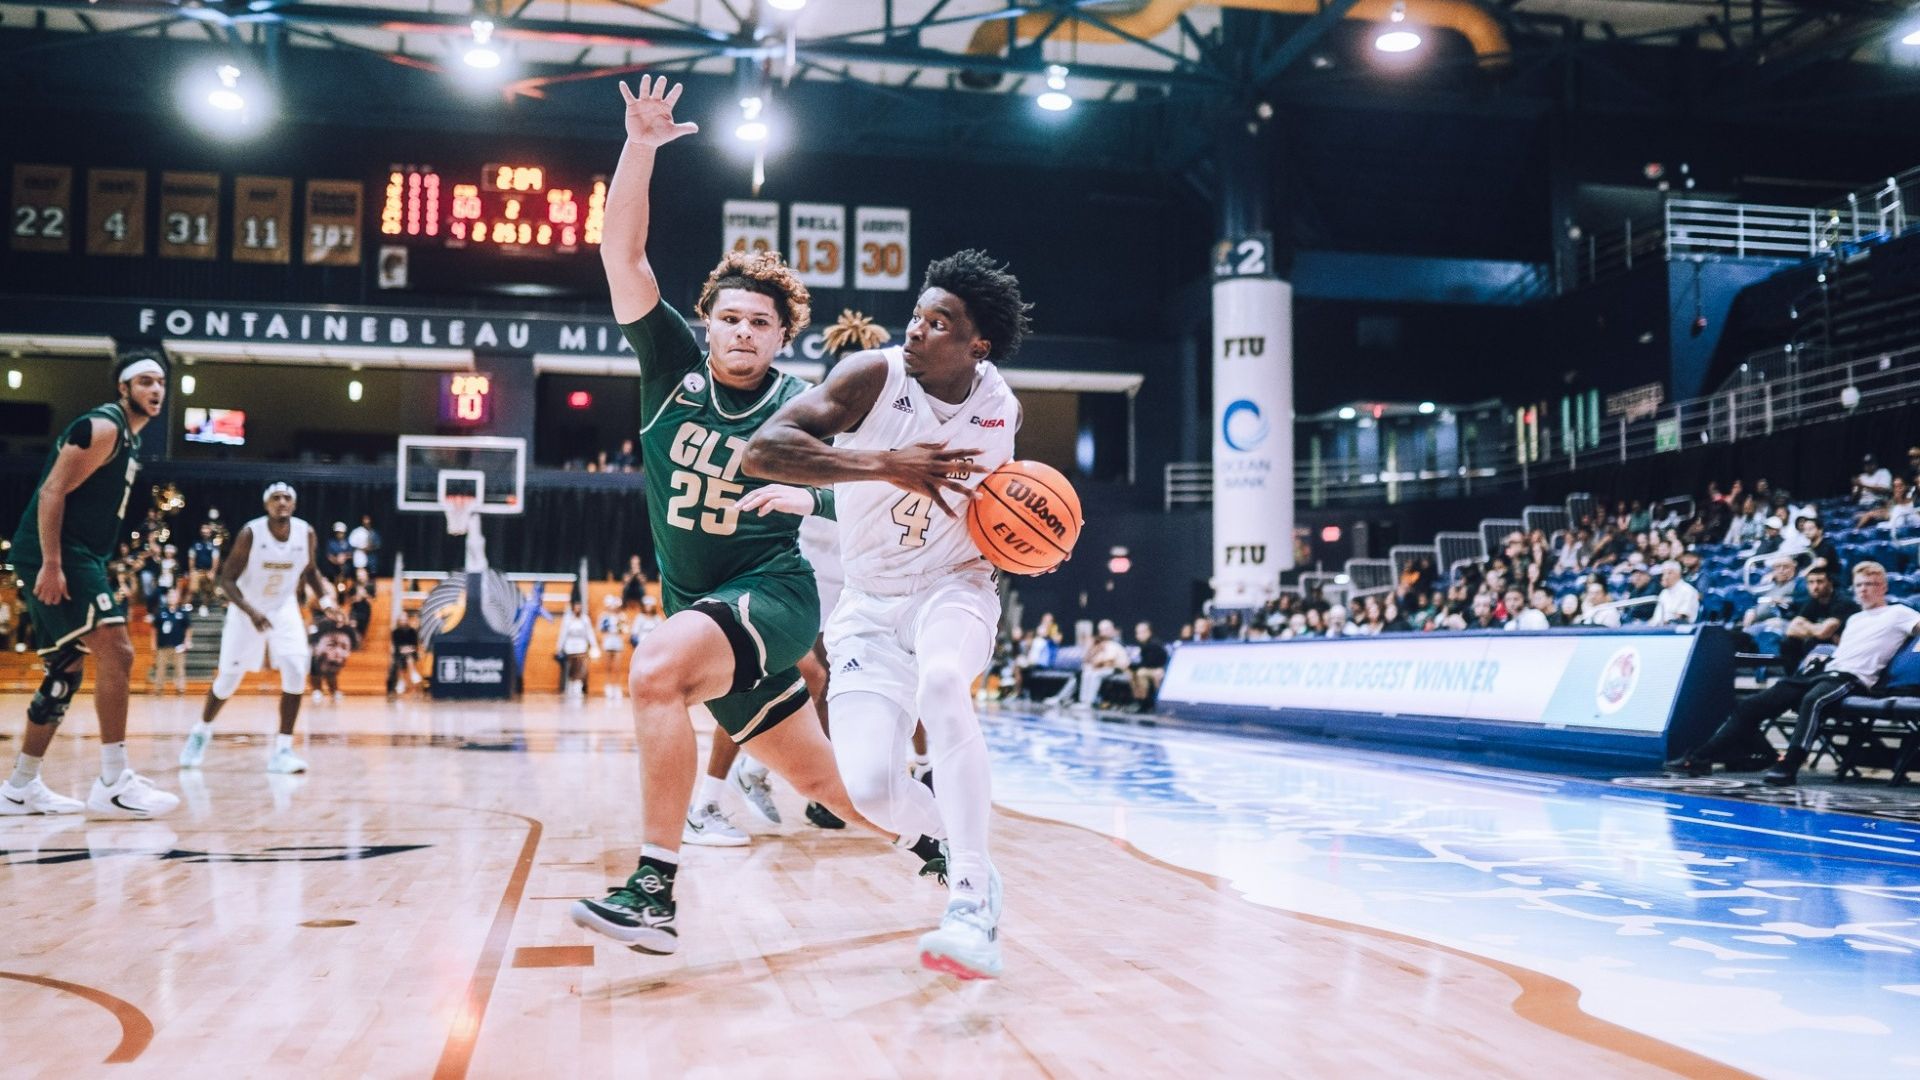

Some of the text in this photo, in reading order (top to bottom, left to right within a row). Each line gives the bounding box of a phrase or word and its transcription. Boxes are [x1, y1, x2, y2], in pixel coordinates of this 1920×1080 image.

[15, 206, 64, 237] 22
[104, 211, 126, 240] 4
[167, 213, 209, 245] 31
[244, 217, 278, 249] 11
[797, 239, 839, 273] 13
[862, 243, 904, 277] 30
[1237, 240, 1265, 275] 2
[139, 308, 530, 349] FONTAINEBLEAU
[1224, 336, 1265, 358] FIU
[667, 470, 744, 536] 25
[1006, 479, 1066, 540] Wilson
[891, 492, 933, 548] 4
[993, 522, 1036, 555] EVO
[1226, 545, 1266, 565] FIU
[1233, 661, 1300, 686] EDUCATION
[1305, 661, 1340, 688] OUR
[1340, 660, 1414, 689] BIGGEST
[1413, 660, 1499, 692] WINNER
